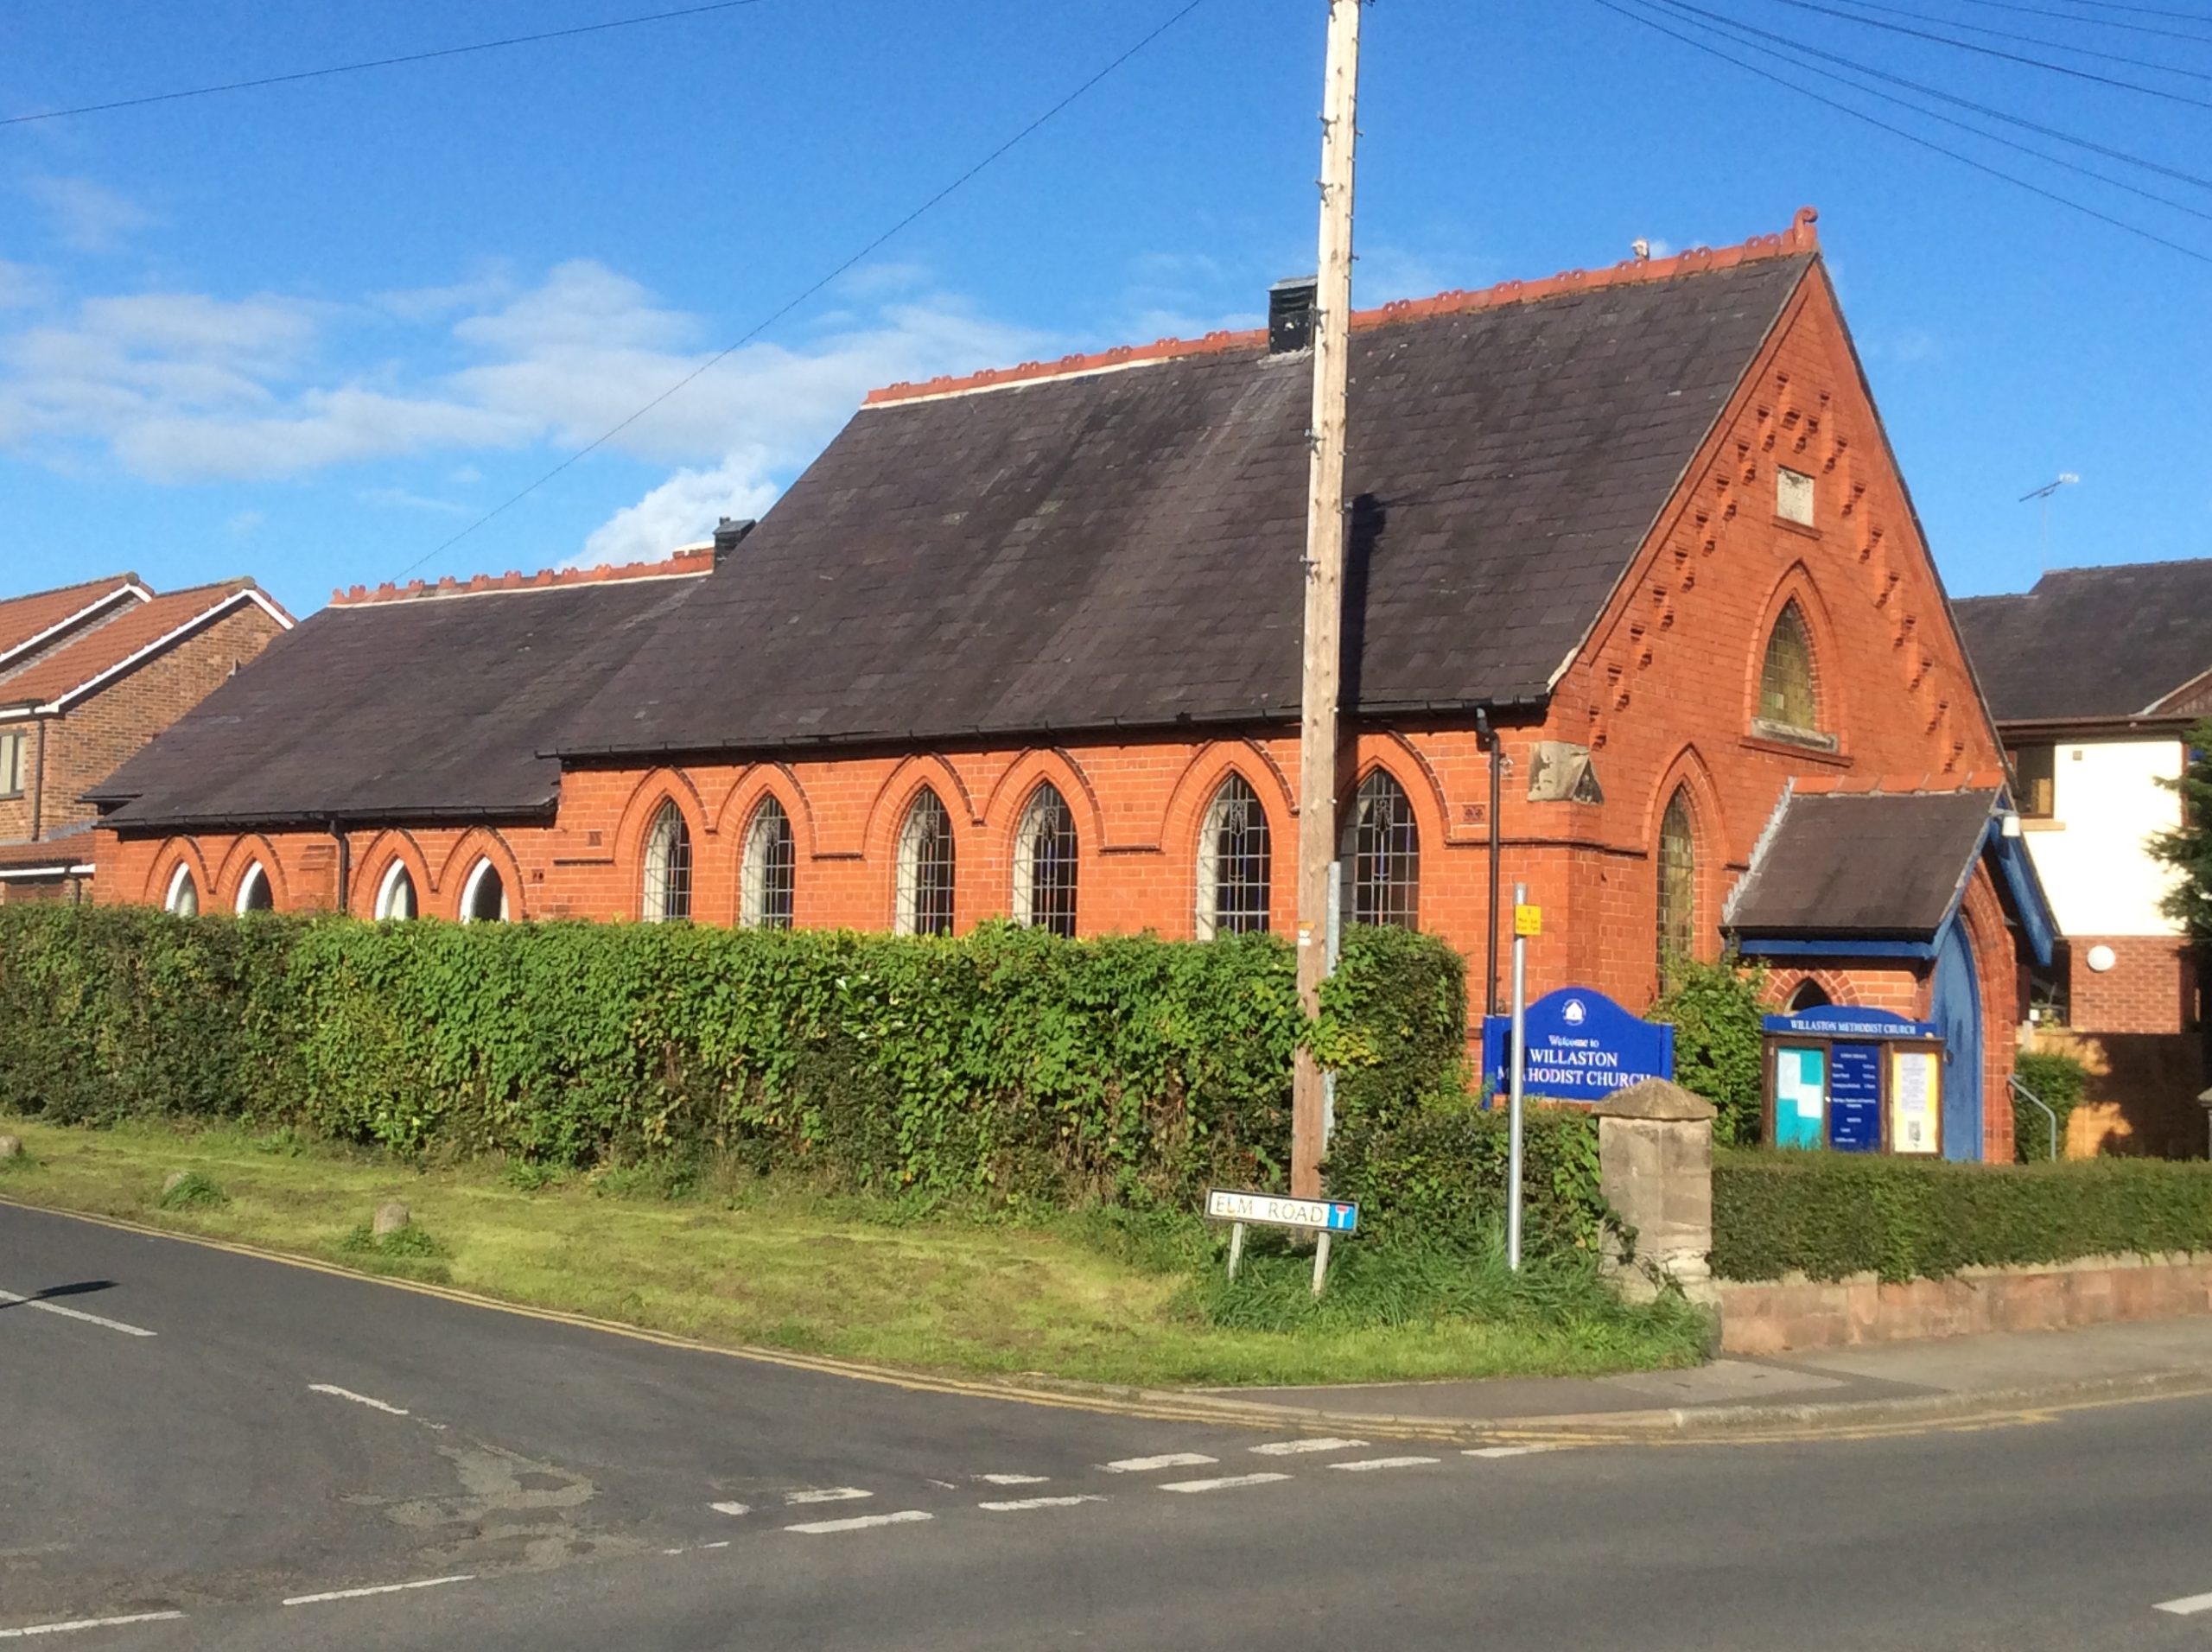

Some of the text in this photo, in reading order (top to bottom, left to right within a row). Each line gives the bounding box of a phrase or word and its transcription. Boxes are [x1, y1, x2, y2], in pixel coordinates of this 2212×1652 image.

[1790, 1020, 1916, 1035] WILLASTON METHODIST CHURCH
[1548, 1035, 1599, 1048] Welcome to
[1529, 1048, 1618, 1067] WILLASTON
[1497, 1064, 1584, 1085] MHODIST
[1216, 1195, 1324, 1223] ELM ROAD
